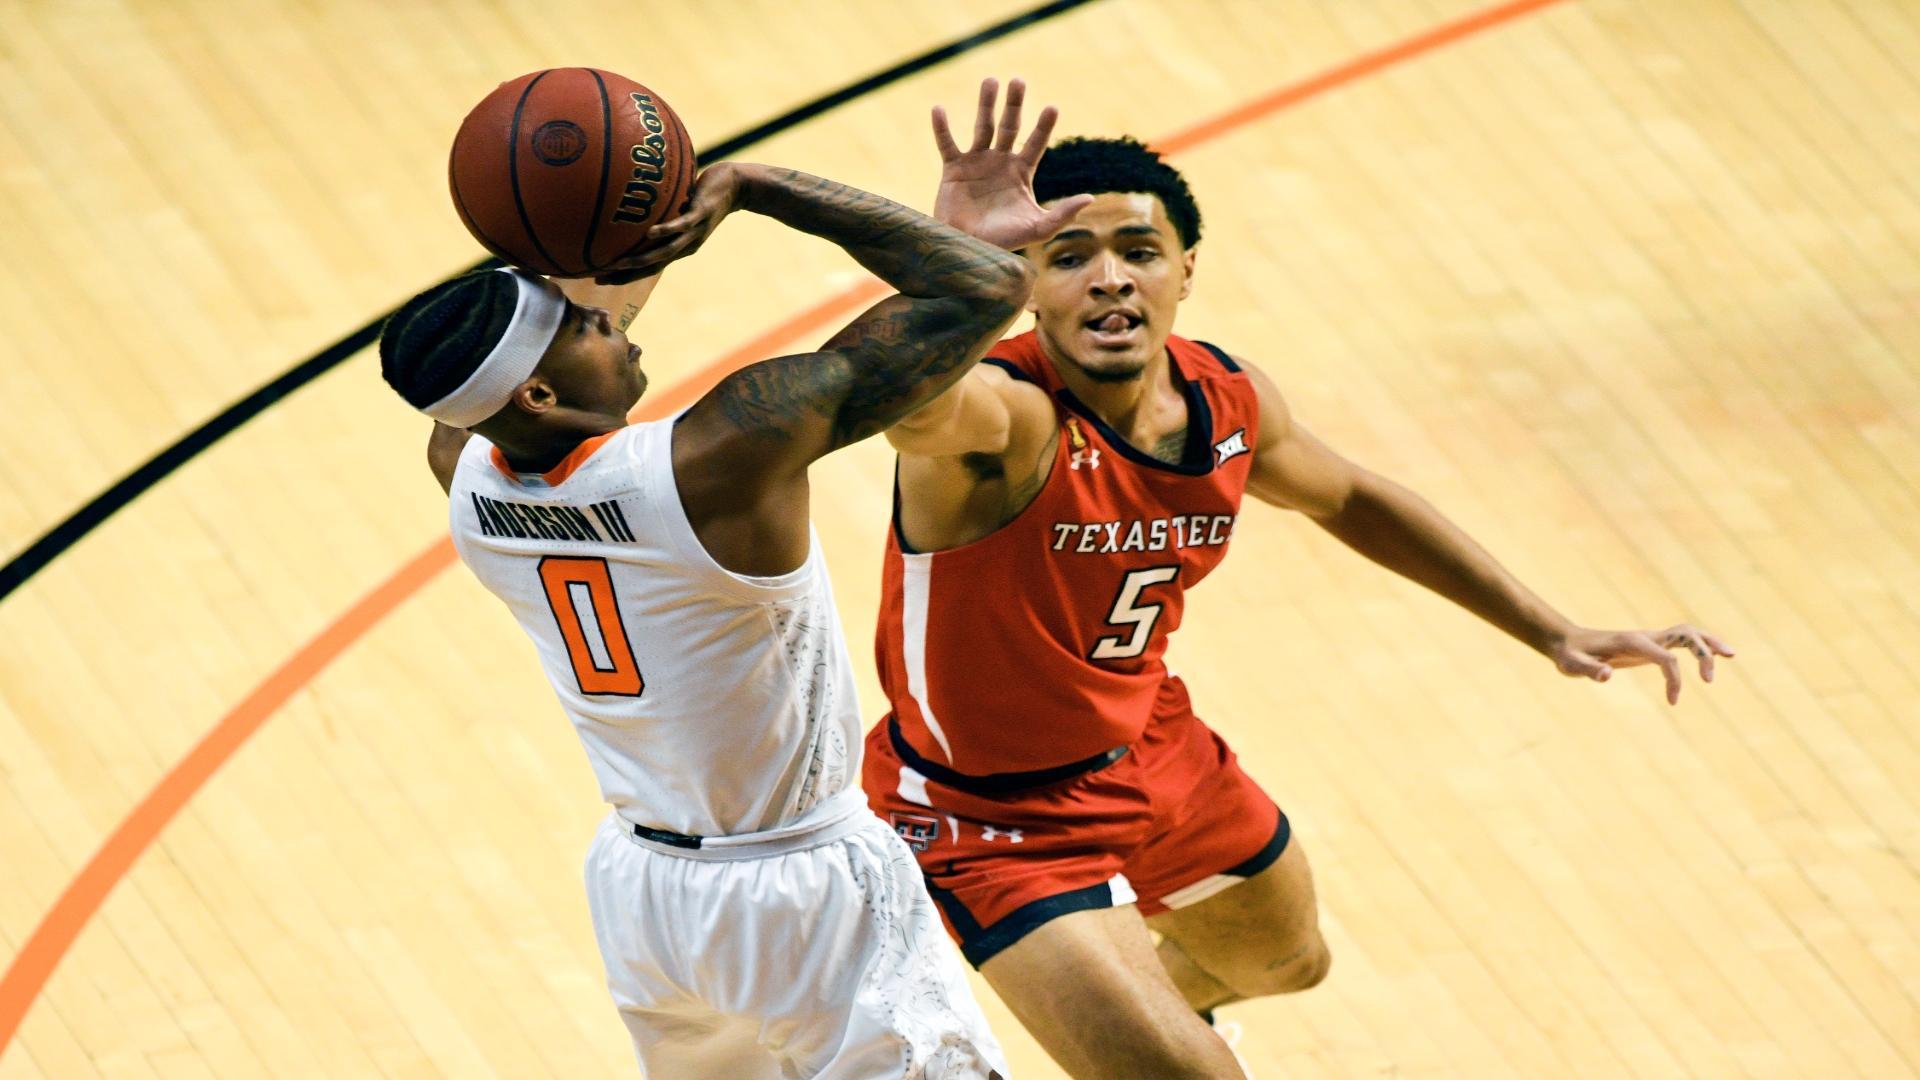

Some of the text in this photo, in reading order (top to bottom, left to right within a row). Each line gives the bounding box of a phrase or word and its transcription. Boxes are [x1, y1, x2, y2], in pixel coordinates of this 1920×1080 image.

[611, 92, 666, 224] Wilson
[471, 491, 637, 543] ANDERSON III
[1052, 519, 1168, 554] TEXAS
[537, 554, 645, 697] 0
[1085, 564, 1182, 661] 5
